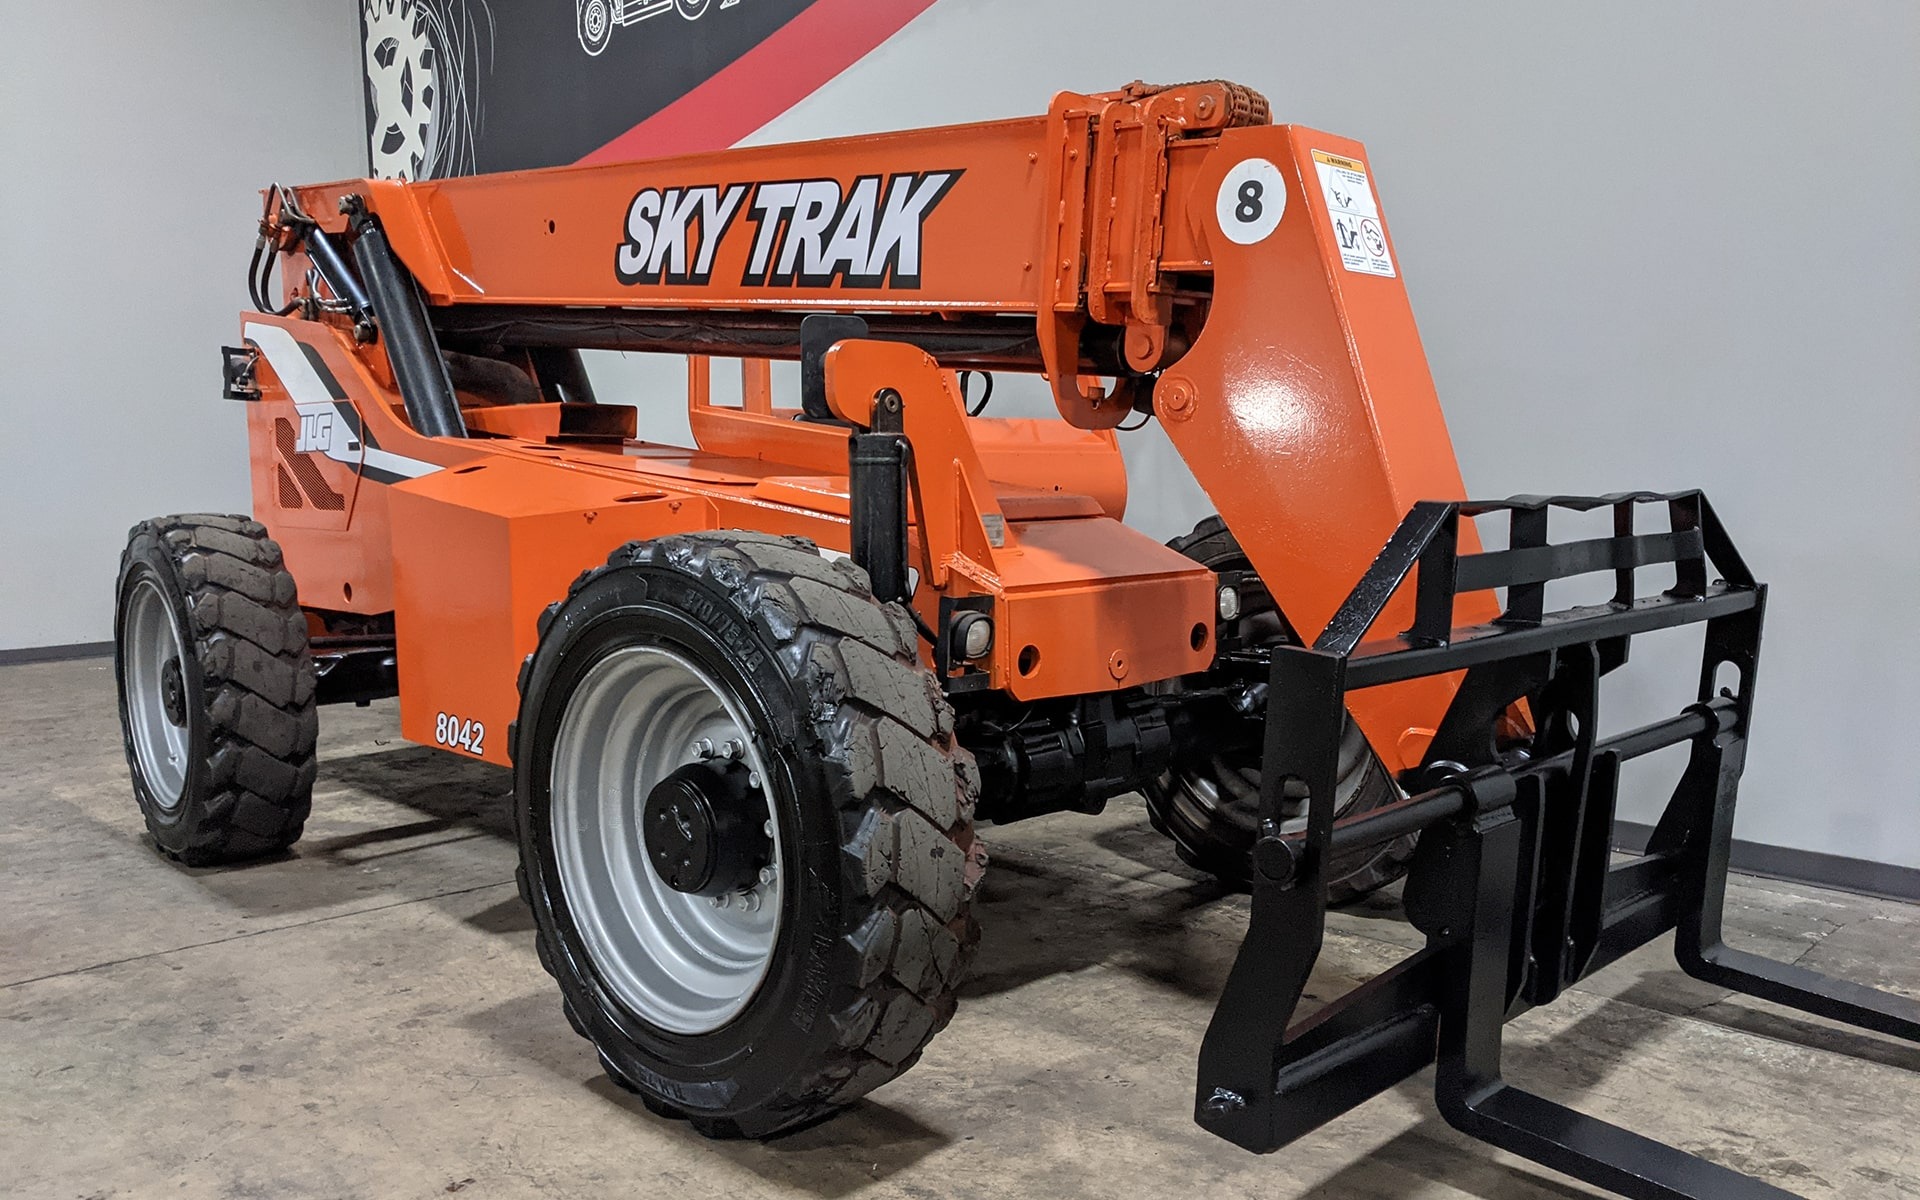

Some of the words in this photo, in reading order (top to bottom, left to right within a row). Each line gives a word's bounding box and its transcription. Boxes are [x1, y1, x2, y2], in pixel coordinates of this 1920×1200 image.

[1235, 180, 1264, 223] 8
[615, 182, 752, 285] SKY
[743, 168, 966, 290] TRAK
[294, 411, 333, 454] JLG
[435, 711, 485, 756] 8042
